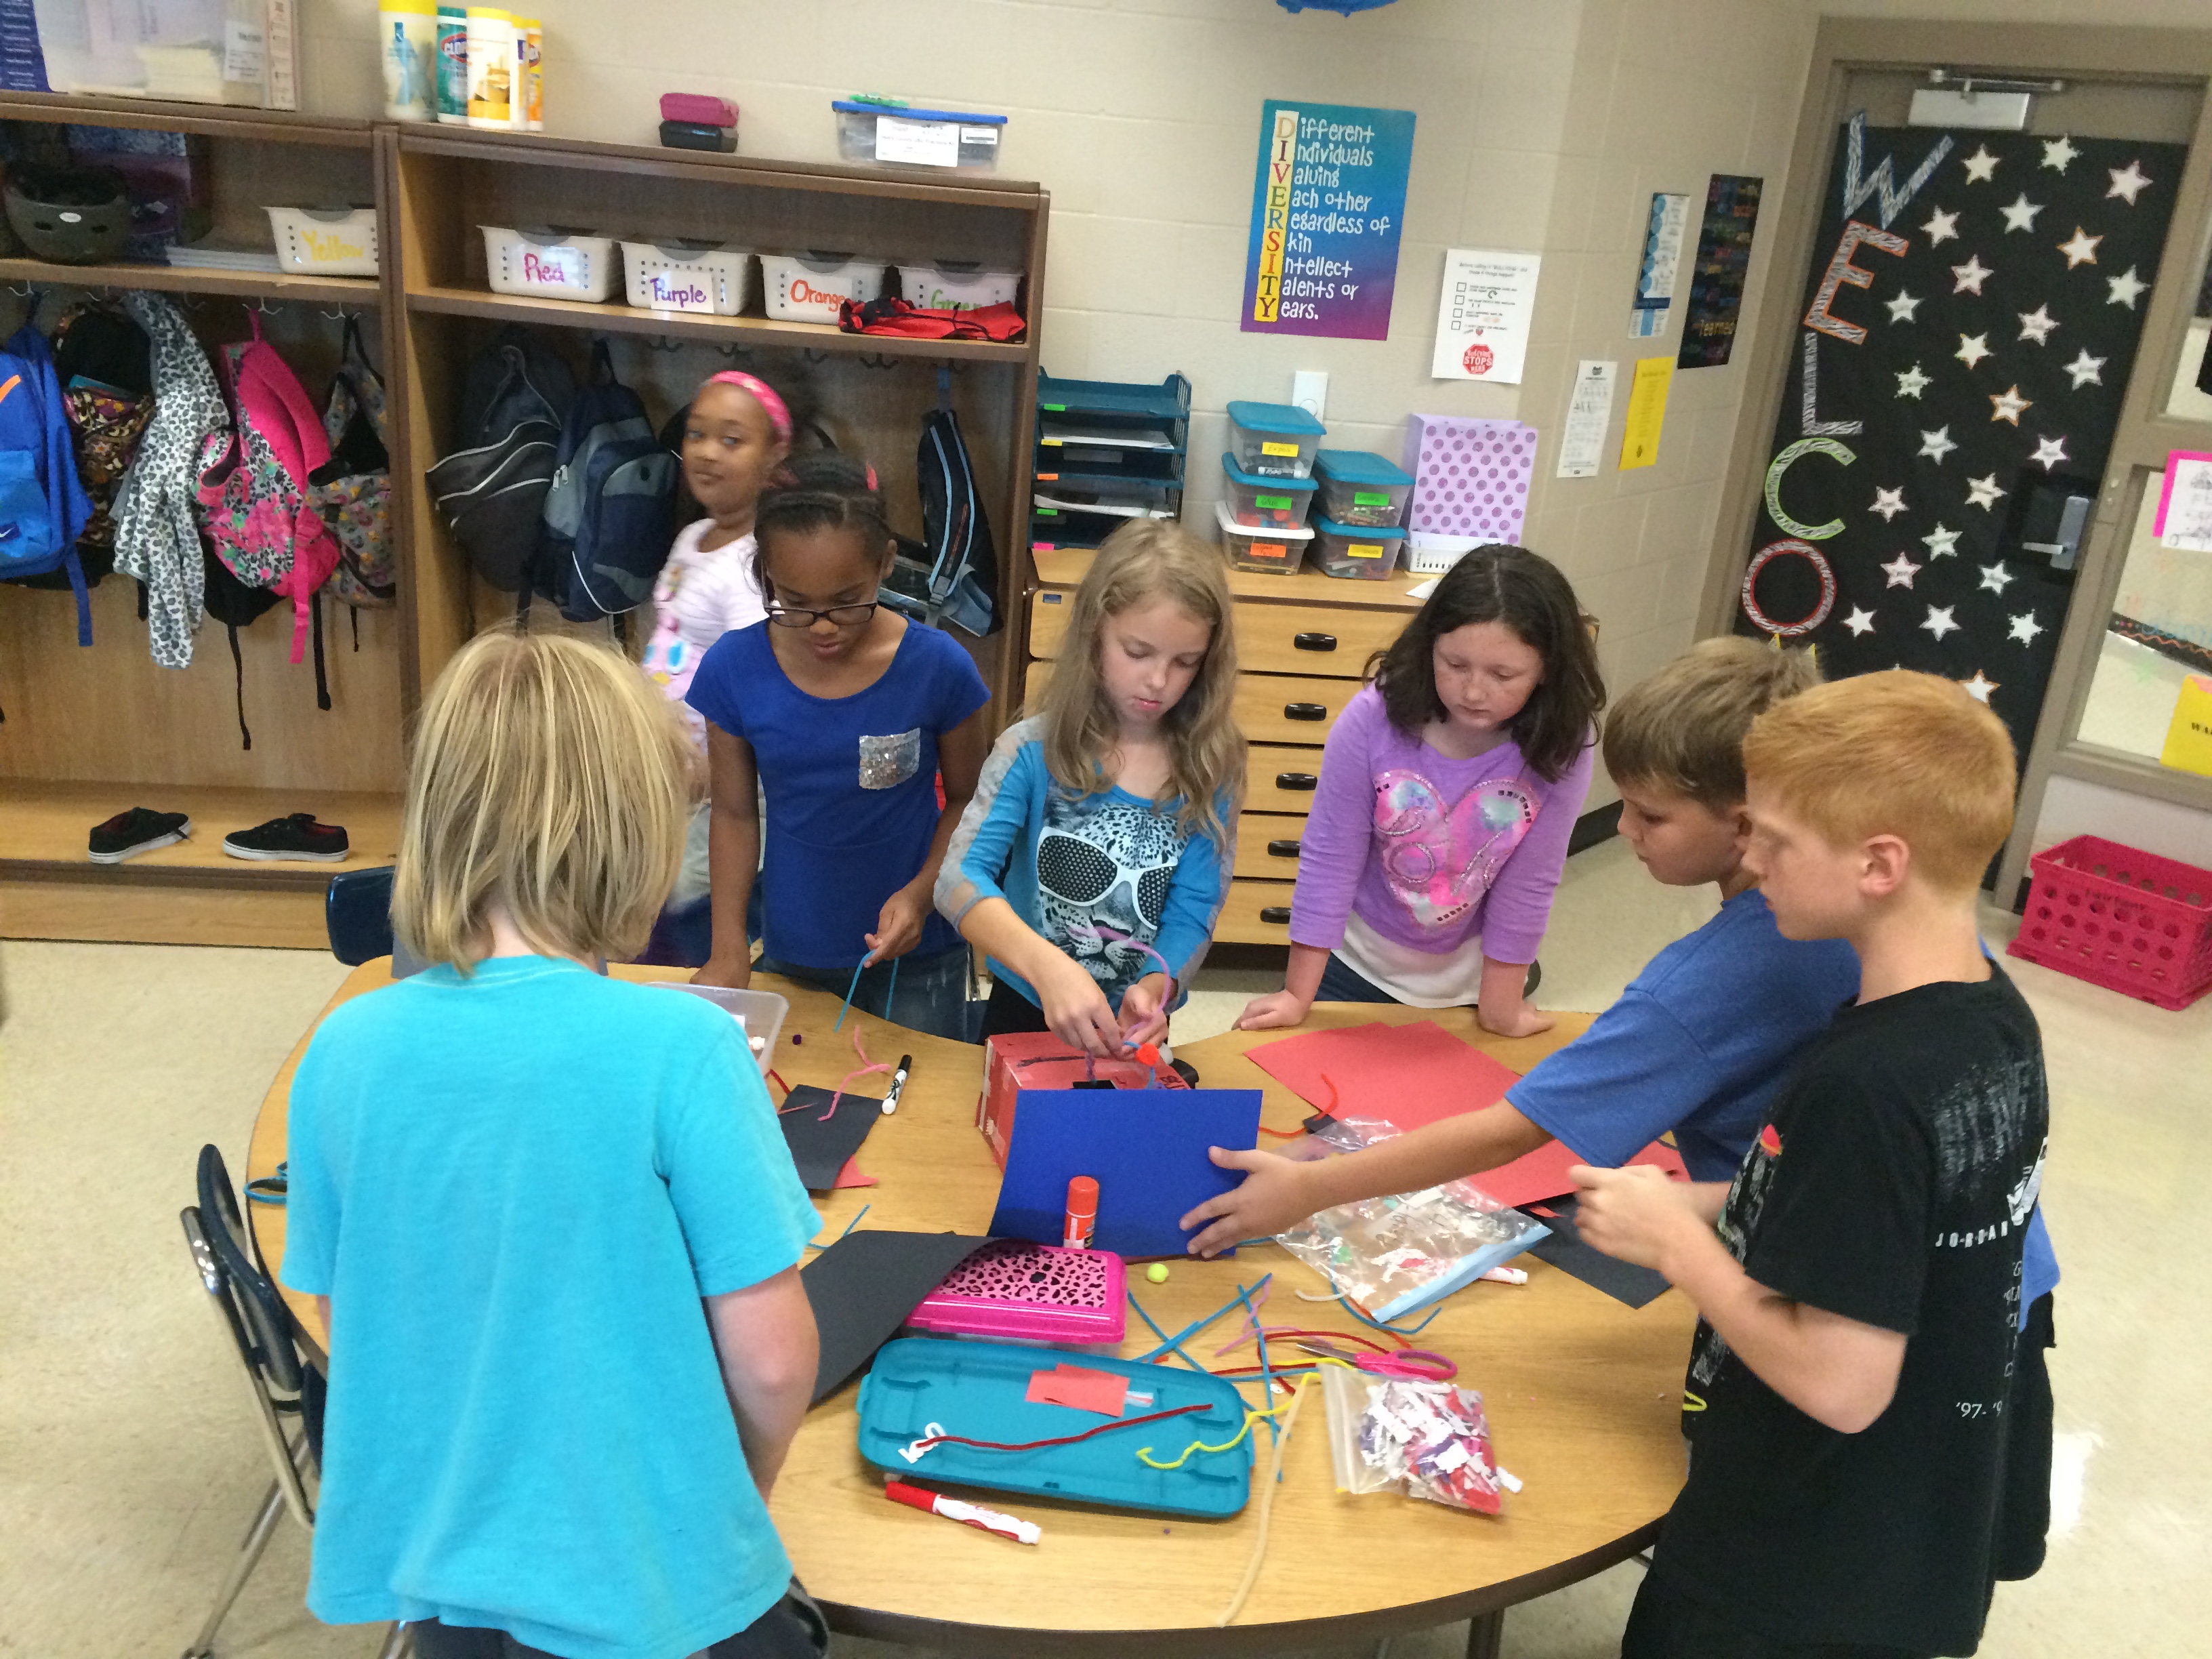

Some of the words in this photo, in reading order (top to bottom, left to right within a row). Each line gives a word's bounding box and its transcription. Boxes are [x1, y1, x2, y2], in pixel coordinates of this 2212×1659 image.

[1325, 190, 1372, 211] other
[1370, 216, 1391, 236] of
[301, 230, 363, 262] Yellow
[524, 253, 564, 282] Red
[650, 277, 707, 308] Purple
[790, 279, 846, 312] Orange
[1341, 284, 1359, 300] or
[1464, 356, 1493, 366] STOPS
[1742, 110, 1954, 647] WELCO
